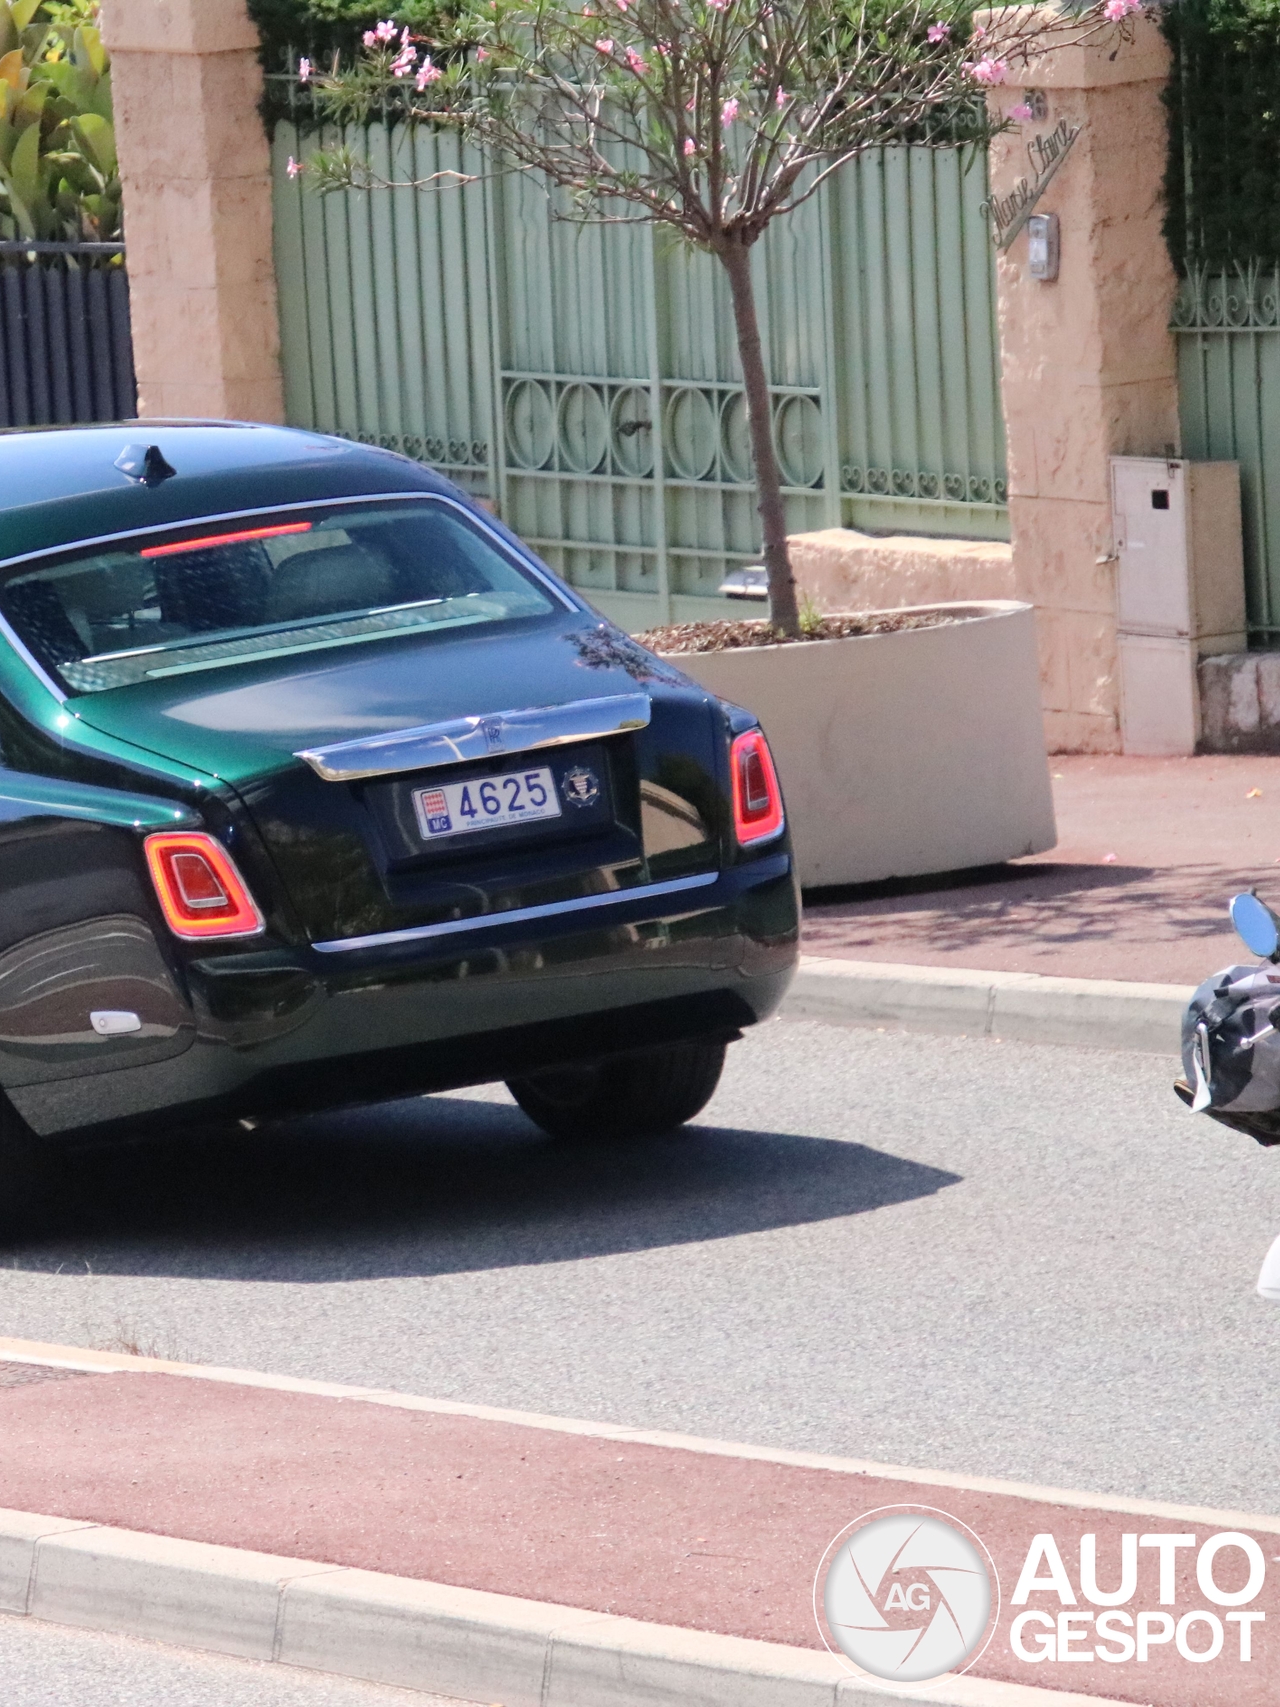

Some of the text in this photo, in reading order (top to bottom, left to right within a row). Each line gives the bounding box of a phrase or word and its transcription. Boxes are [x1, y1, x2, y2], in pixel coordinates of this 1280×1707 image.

[460, 773, 548, 819] 4625
[519, 808, 546, 818] MONACO
[432, 817, 448, 830] MC
